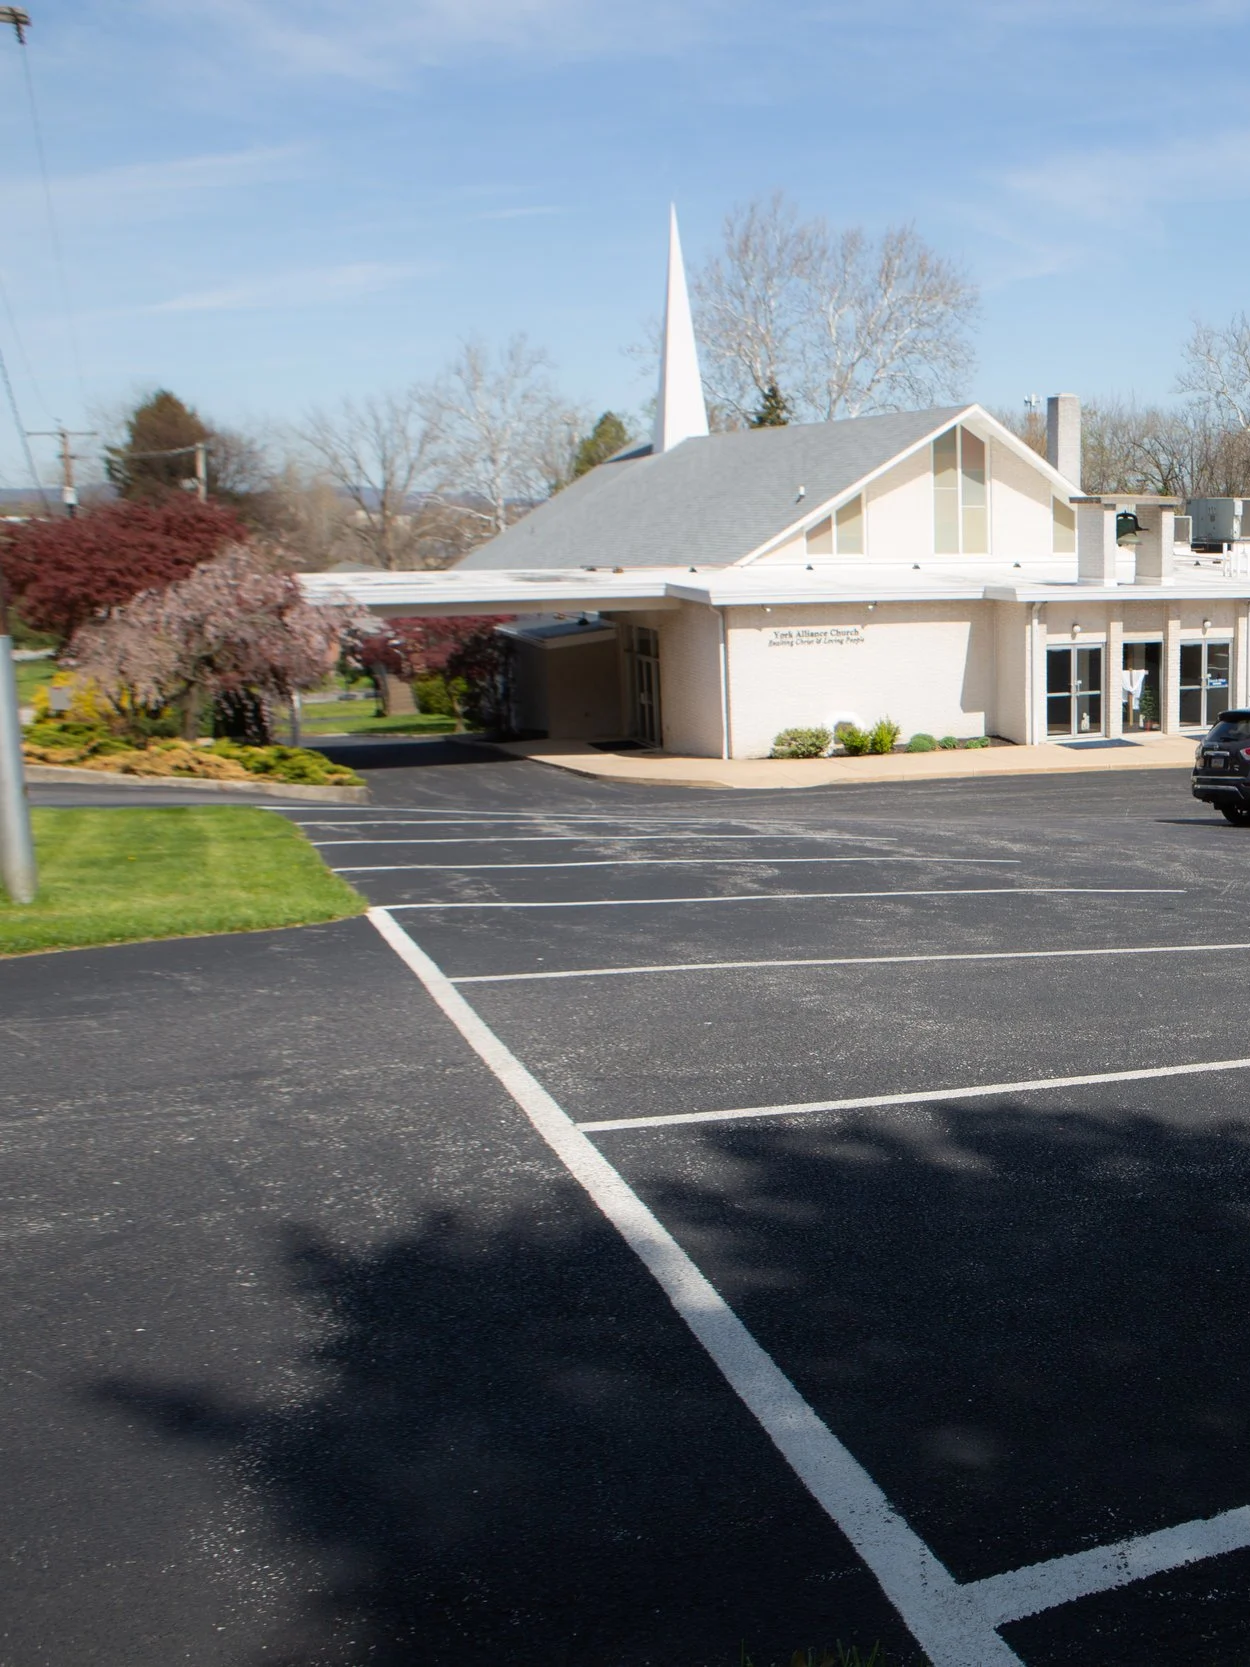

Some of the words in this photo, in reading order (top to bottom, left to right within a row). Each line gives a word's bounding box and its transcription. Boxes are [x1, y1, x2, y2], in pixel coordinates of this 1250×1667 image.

[774, 631, 793, 639] York
[796, 630, 828, 638] Alliance
[830, 628, 859, 637] Church
